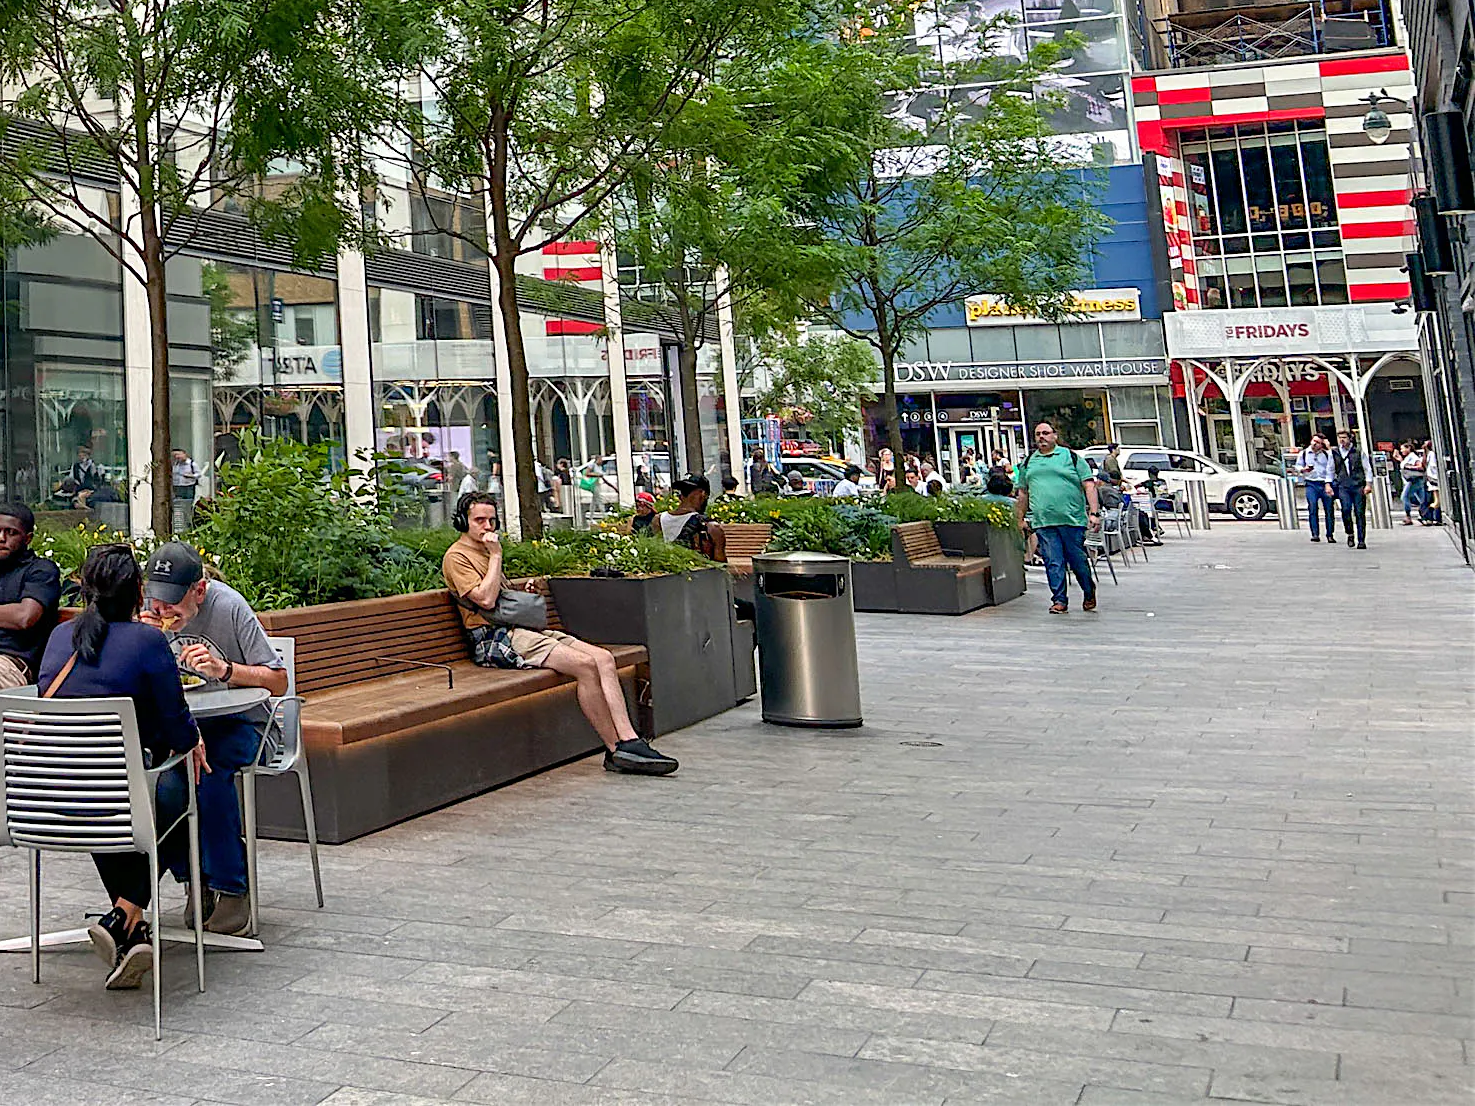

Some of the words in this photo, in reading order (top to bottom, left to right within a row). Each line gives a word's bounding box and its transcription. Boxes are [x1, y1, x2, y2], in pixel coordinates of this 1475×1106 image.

[1234, 323, 1310, 340] FRIDAYS
[893, 360, 953, 383] DSW
[958, 365, 1026, 380] DESIGNER
[1029, 364, 1066, 377] SHOE
[1069, 362, 1158, 376] WAREHOUSE
